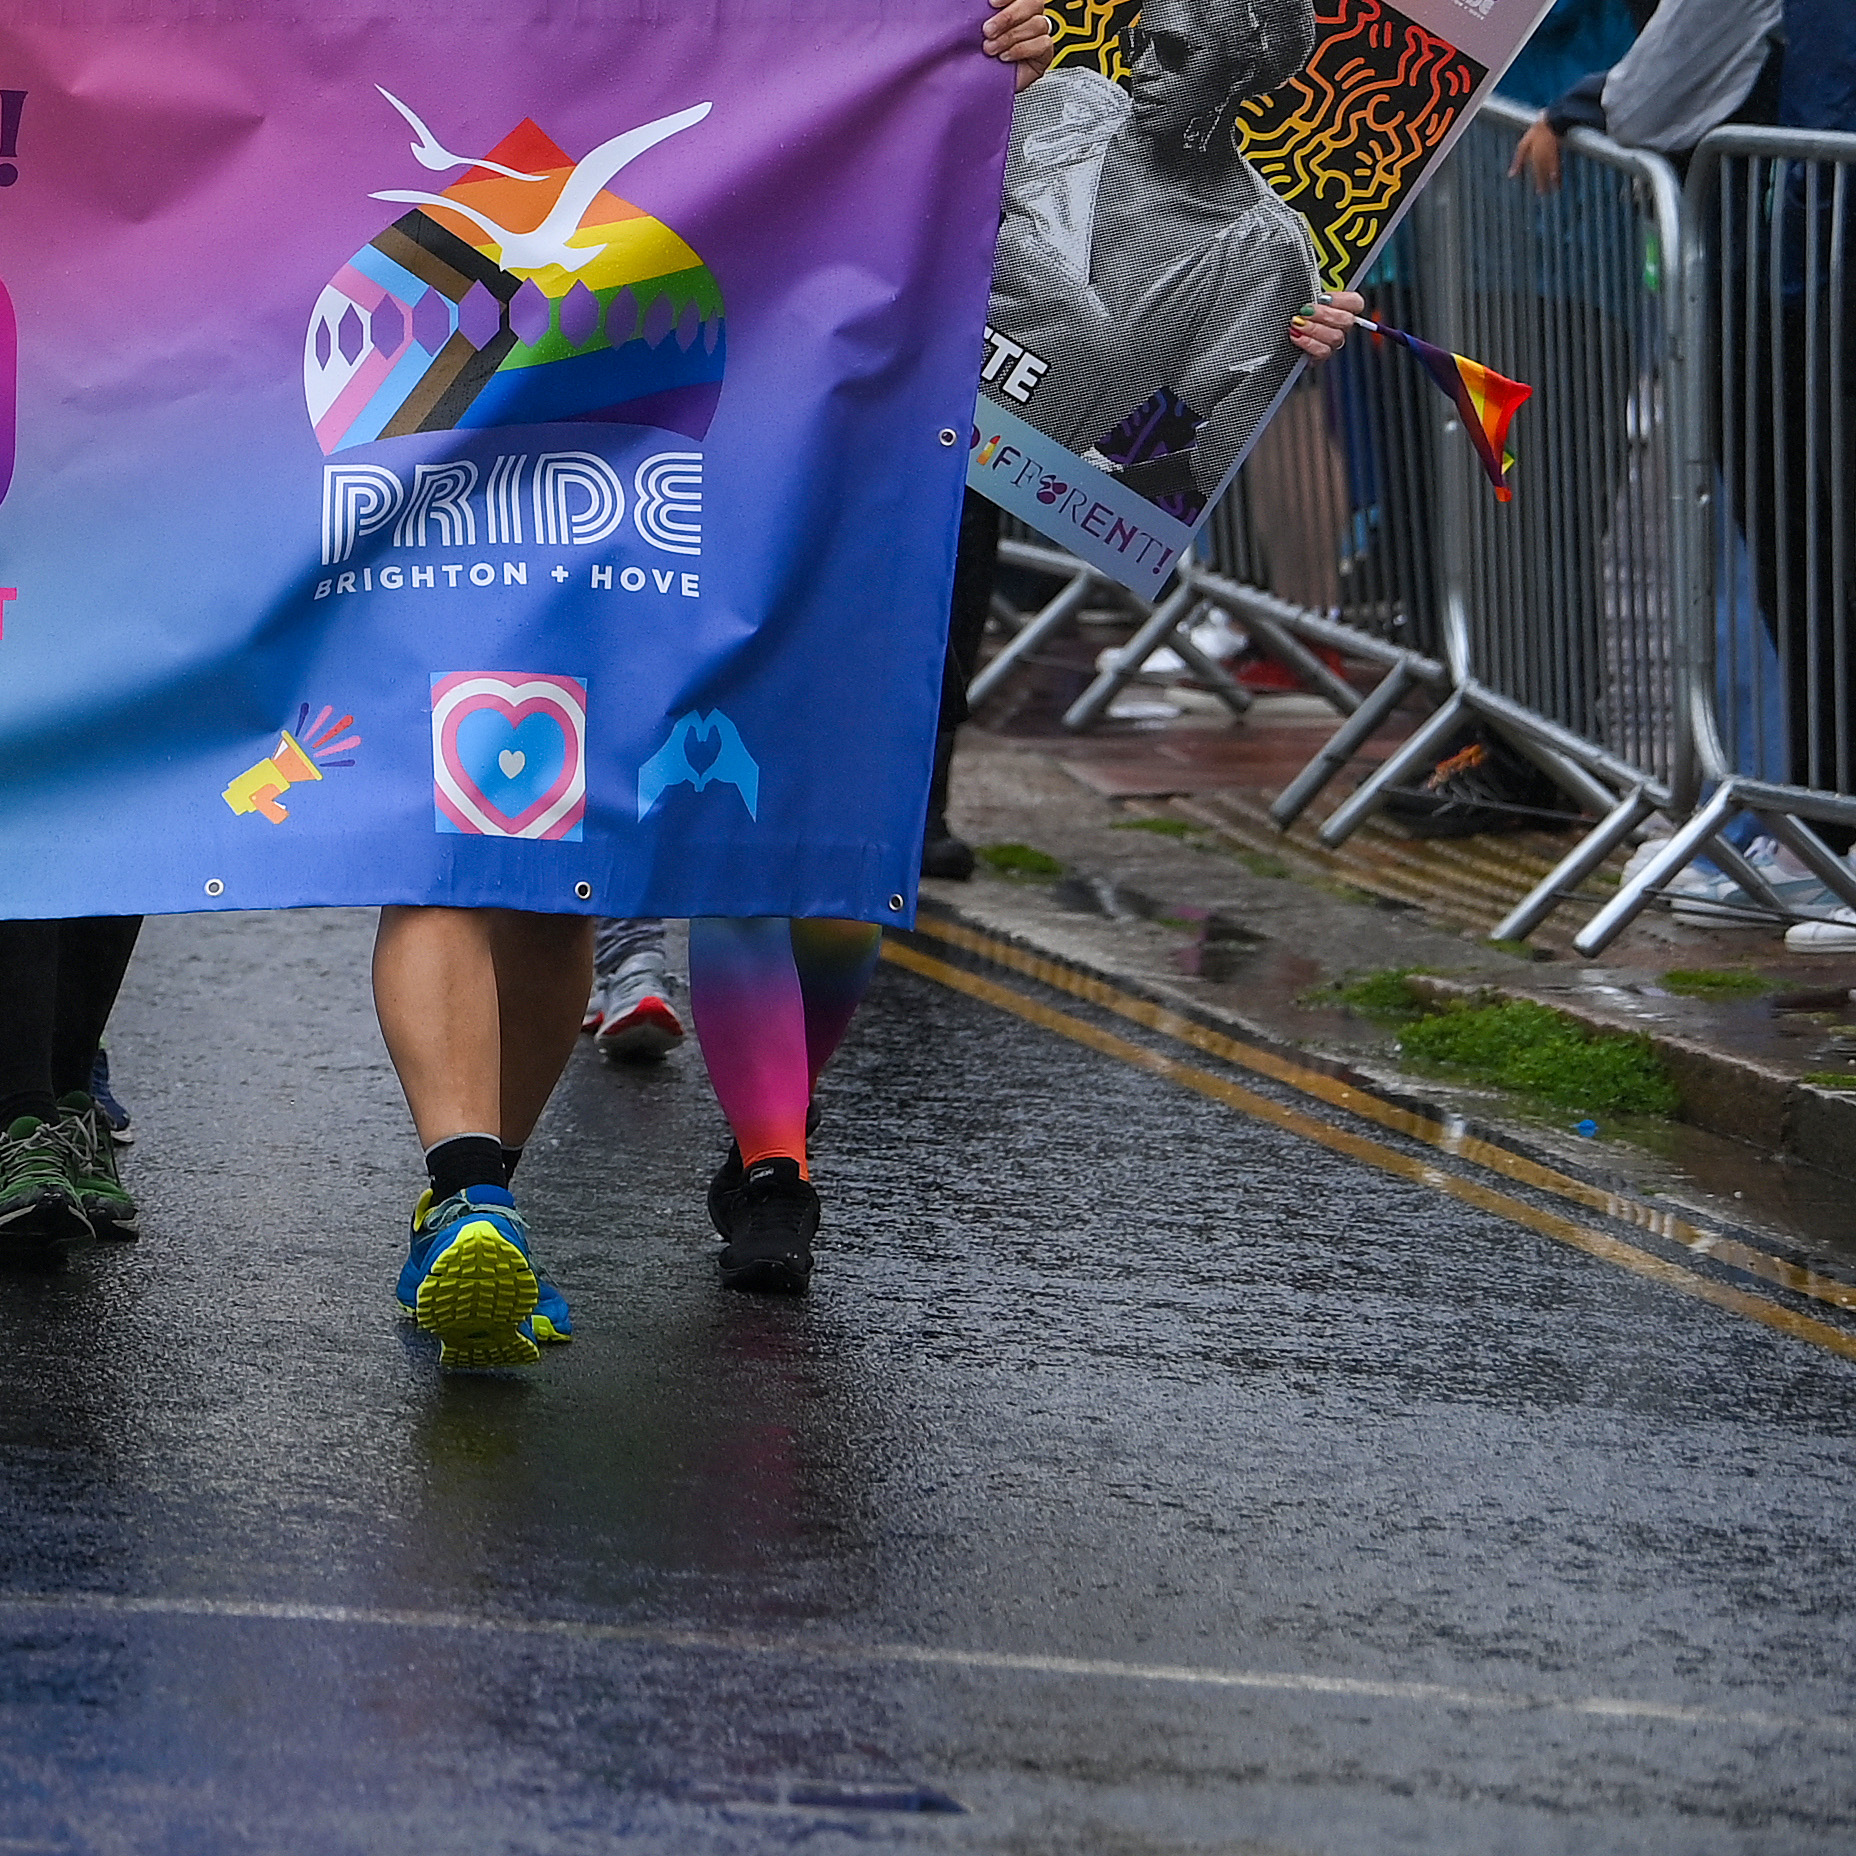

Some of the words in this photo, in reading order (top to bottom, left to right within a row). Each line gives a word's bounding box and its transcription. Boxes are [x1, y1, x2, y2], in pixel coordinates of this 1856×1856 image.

[983, 325, 1049, 403] TE
[322, 451, 704, 566] PRIDE
[970, 424, 1174, 575] IFFERENT!
[314, 562, 529, 600] BRIGHTON
[591, 564, 701, 598] HOVE
